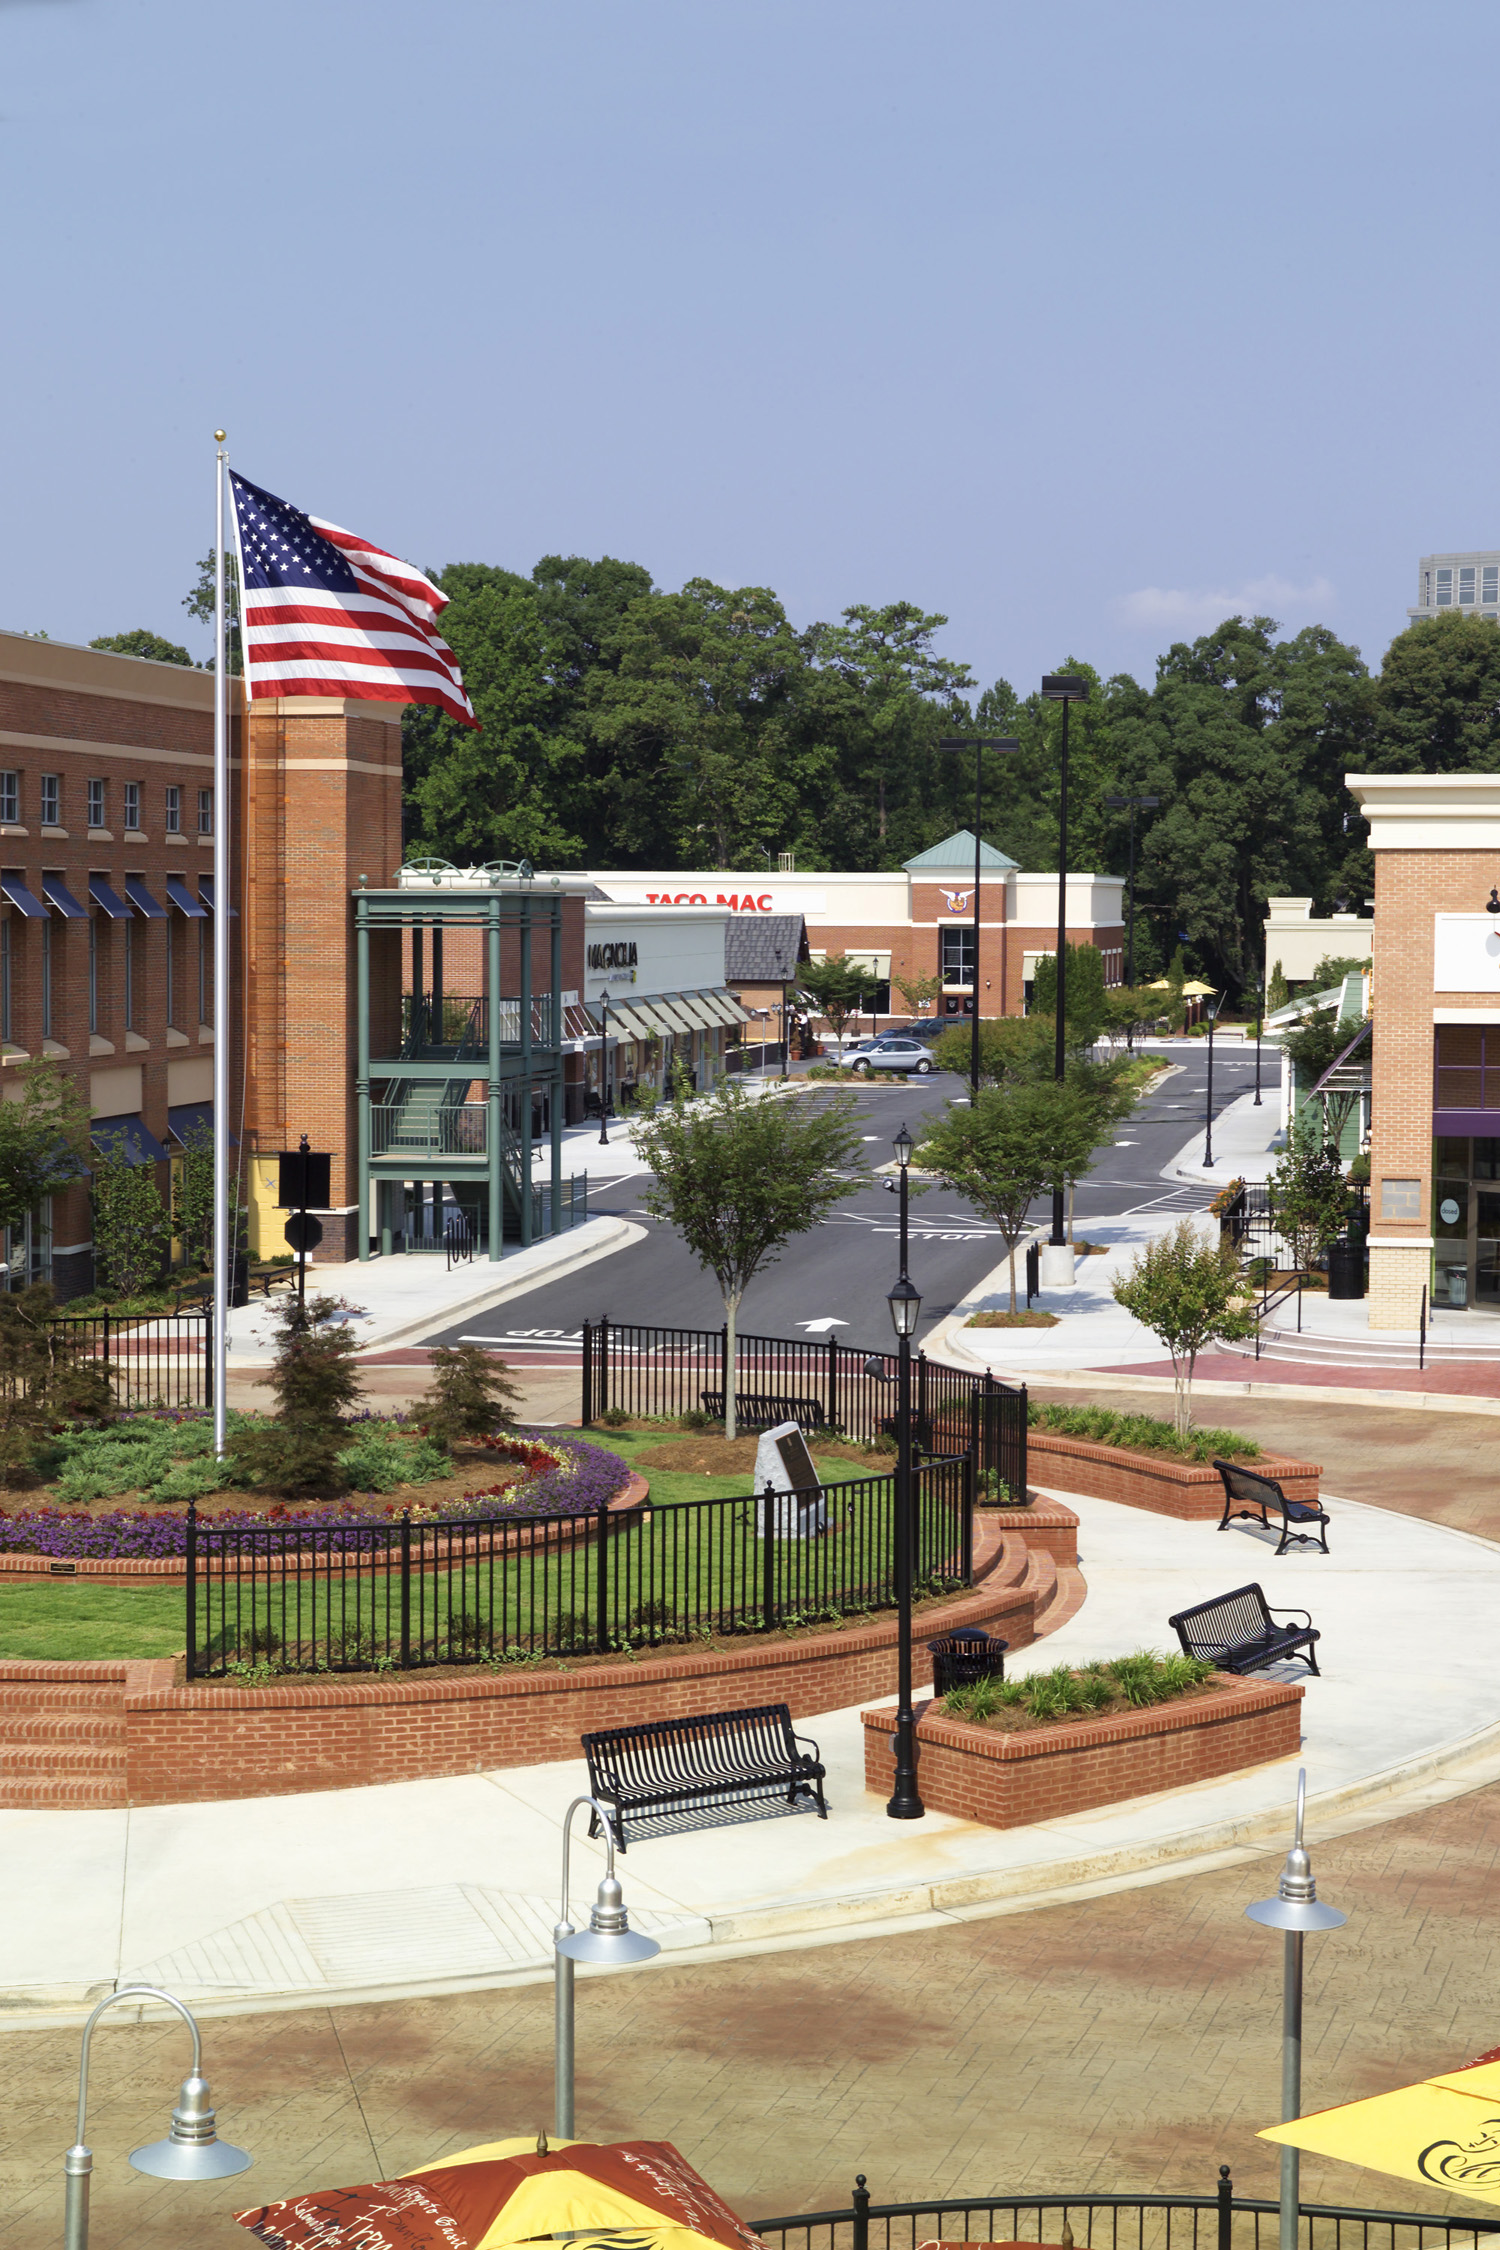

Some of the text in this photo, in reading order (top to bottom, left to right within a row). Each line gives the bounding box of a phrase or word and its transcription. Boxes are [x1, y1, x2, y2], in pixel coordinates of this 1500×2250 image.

[645, 893, 773, 911] TACO MAC
[588, 942, 638, 969] MAGNOLIA
[893, 1232, 987, 1240] STOP
[434, 2216, 467, 2250] Basil
